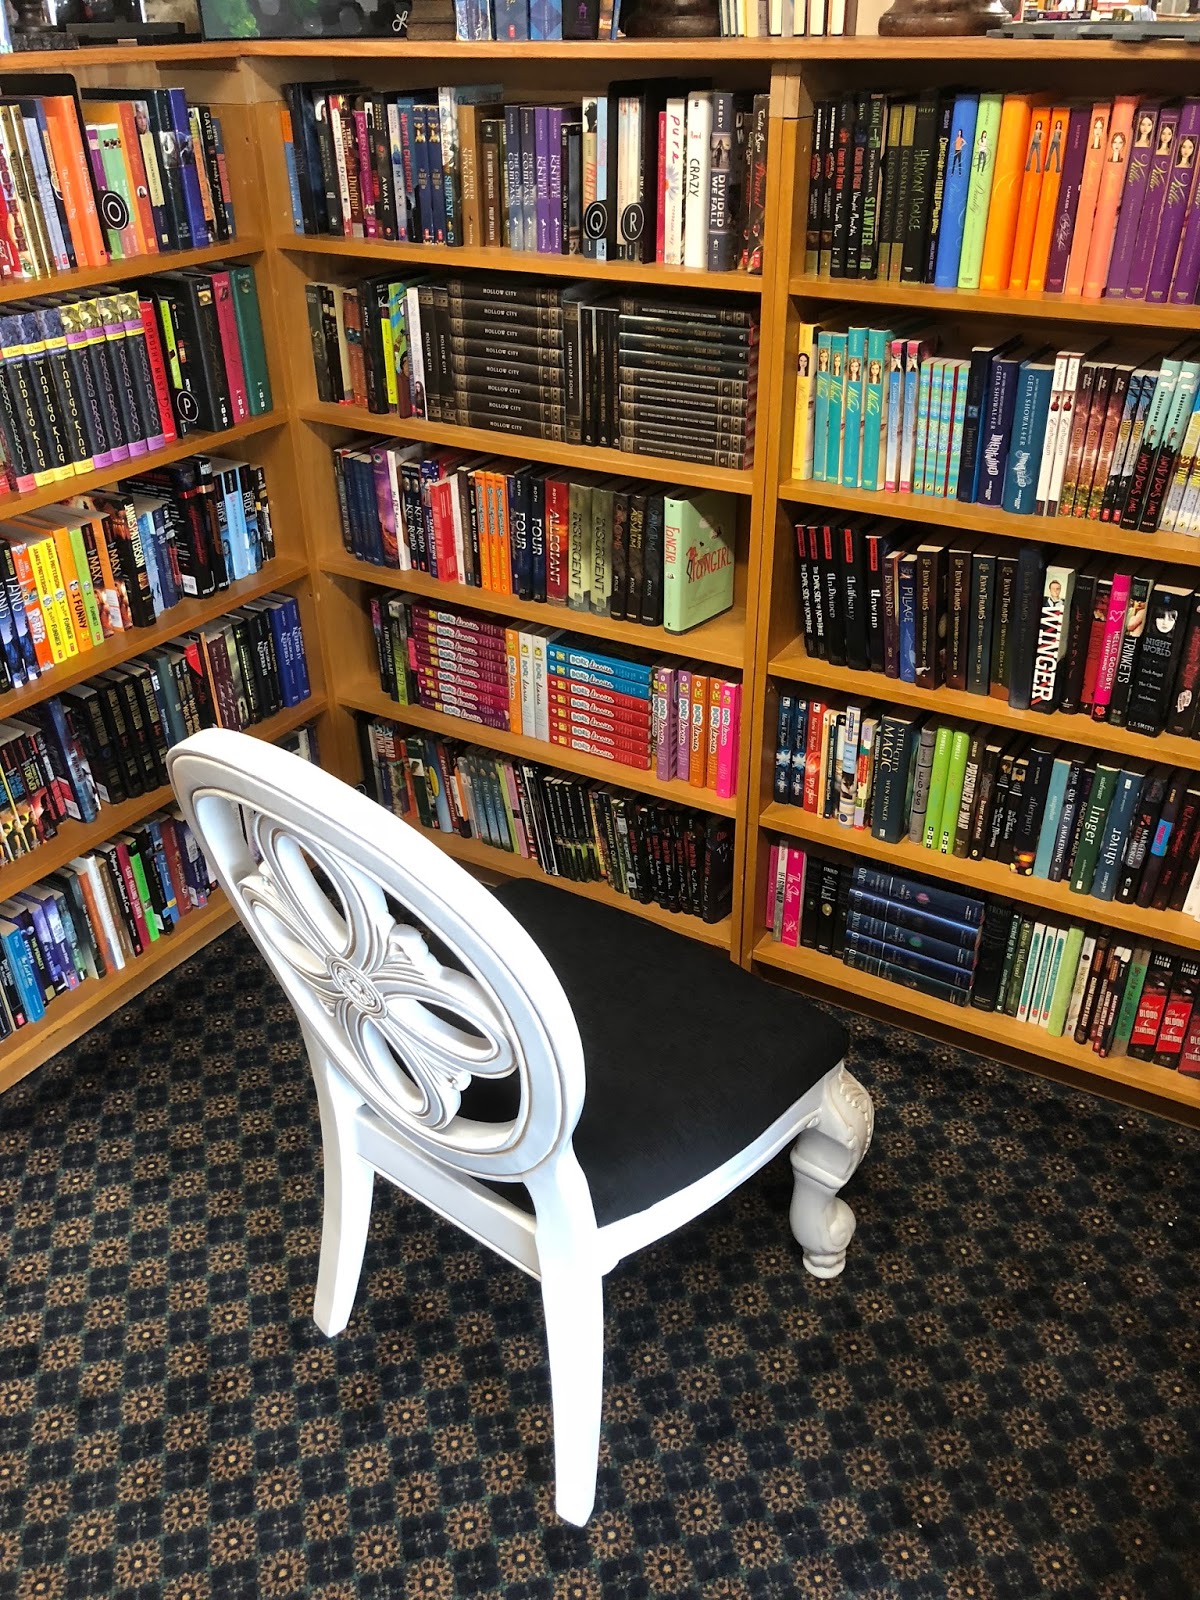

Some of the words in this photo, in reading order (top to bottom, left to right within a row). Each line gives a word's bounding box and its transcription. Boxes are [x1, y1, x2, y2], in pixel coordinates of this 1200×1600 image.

[872, 102, 880, 124] SHAN
[203, 112, 213, 141] OATES
[689, 158, 701, 198] CRAZY
[711, 175, 718, 191] WE
[381, 176, 390, 211] AWAKE
[444, 175, 454, 217] SERPENT
[718, 174, 726, 227] DIVIDED
[108, 201, 122, 222] O
[590, 210, 603, 233] Q
[630, 212, 637, 232] R
[861, 197, 875, 246] SLAWTER
[155, 367, 164, 391] MUST
[508, 368, 520, 376] CITY
[995, 365, 1003, 387] GENA
[1026, 375, 1034, 397] GENA
[183, 398, 191, 415] P
[511, 423, 523, 431] CITY
[243, 493, 252, 517] RIDE
[516, 512, 526, 550] FOUR
[532, 518, 542, 556] FOUR
[550, 508, 560, 585] ALLEGIANT
[571, 511, 582, 589] INSURGENT
[89, 556, 103, 580] MAX
[109, 548, 122, 574] MAX
[73, 600, 88, 629] FUNNY
[902, 587, 914, 623] PILLAGE
[456, 617, 479, 631] diaries
[454, 641, 477, 656] diaries
[1032, 604, 1065, 704] WINGER
[1142, 644, 1171, 658] WORLD
[1145, 637, 1171, 650] NIGHT
[456, 664, 480, 678] diaries
[589, 660, 614, 674] diaries
[1118, 637, 1137, 684] TRINKETS
[457, 687, 478, 701] diaries
[522, 678, 530, 703] diaries
[590, 690, 614, 703] diaries
[460, 709, 482, 723] diaries
[590, 718, 614, 732] diaries
[658, 718, 667, 745] diaries
[692, 724, 702, 751] diaries
[721, 724, 729, 746] diaries
[939, 731, 947, 755] SPINELLI
[590, 745, 614, 759] diaries
[880, 724, 896, 773] MAGIC
[962, 761, 979, 803] PRISONER
[1085, 805, 1105, 845] linger
[1055, 824, 1068, 863] AWAKENING
[1104, 828, 1122, 866] shiver
[1139, 1009, 1158, 1019] BLOOD
[1165, 1017, 1185, 1028] BLOOD
